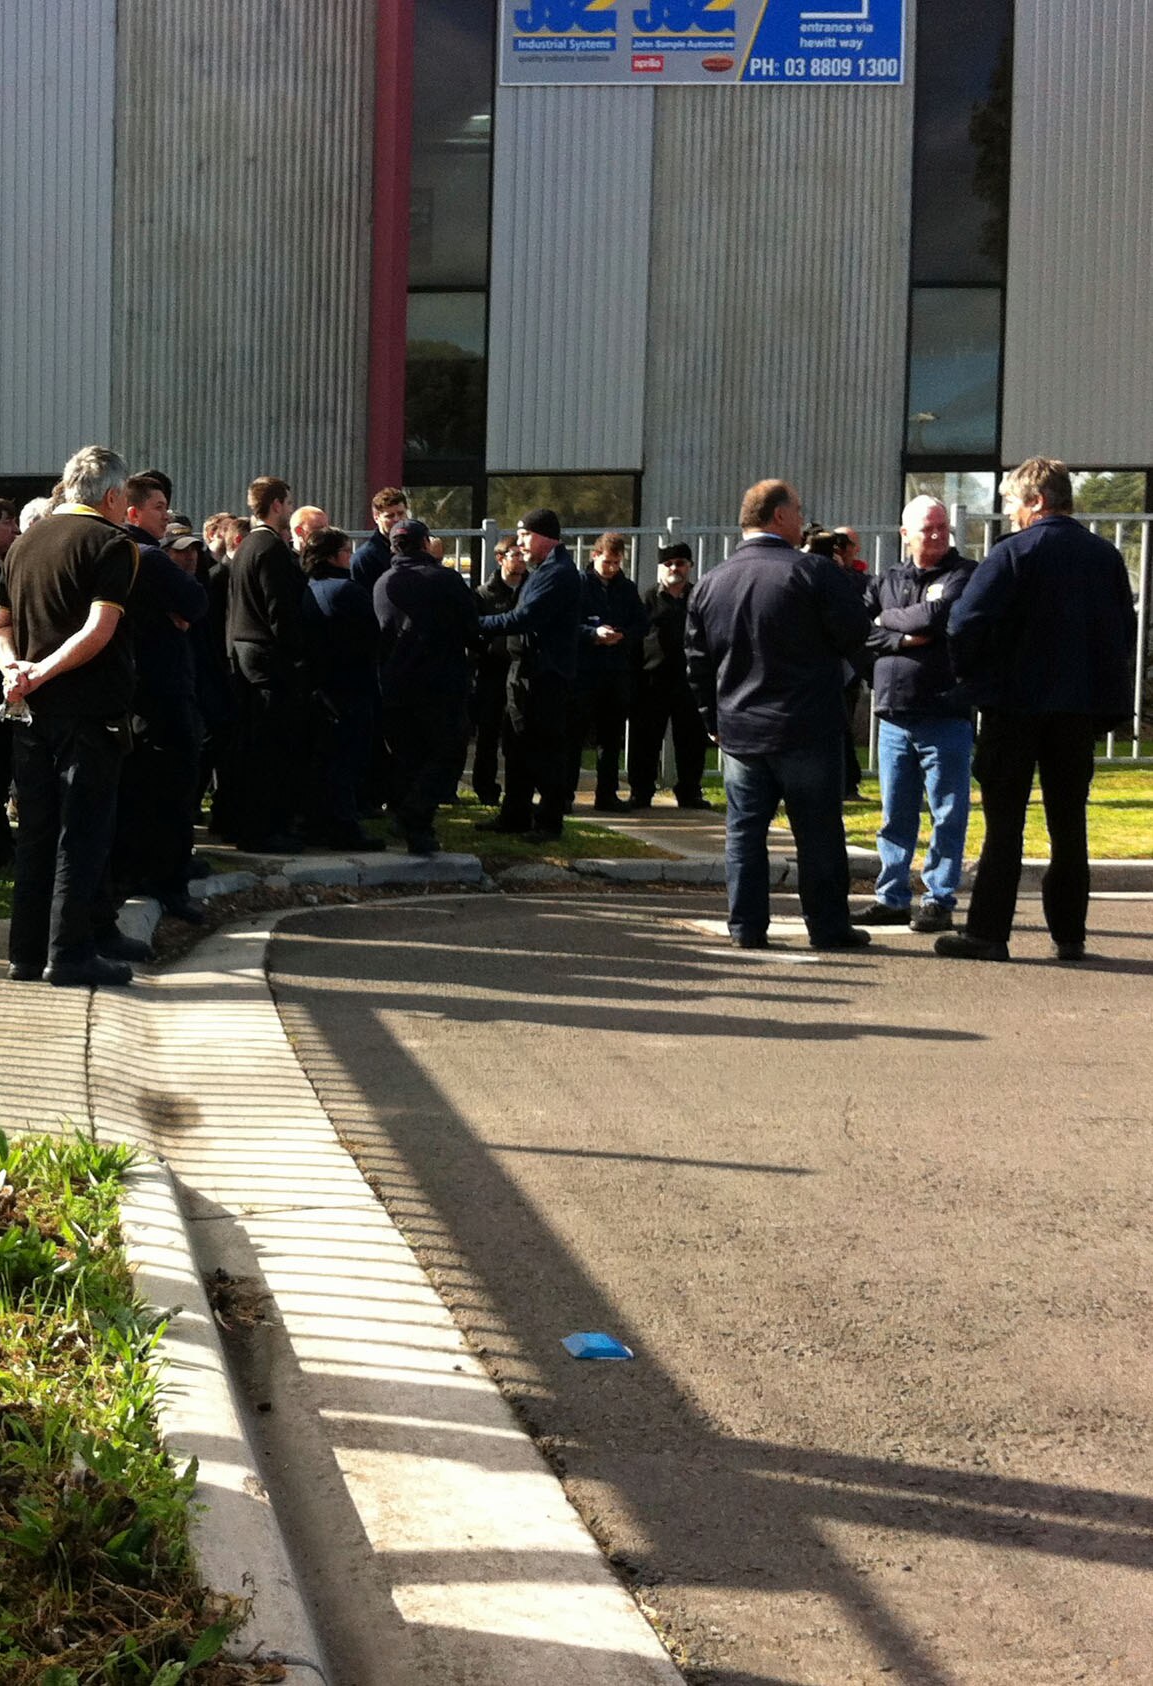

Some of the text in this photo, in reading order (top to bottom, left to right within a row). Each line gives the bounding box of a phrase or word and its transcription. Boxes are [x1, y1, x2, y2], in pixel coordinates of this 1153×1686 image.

[799, 21, 874, 33] entrance via
[518, 38, 611, 51] Industrial Systems
[632, 40, 734, 50] John Sample Automotive
[799, 37, 864, 51] hewitt way
[749, 58, 780, 76] PH:
[784, 58, 806, 76] 03
[810, 58, 853, 76] 8809
[857, 58, 898, 76] 1300
